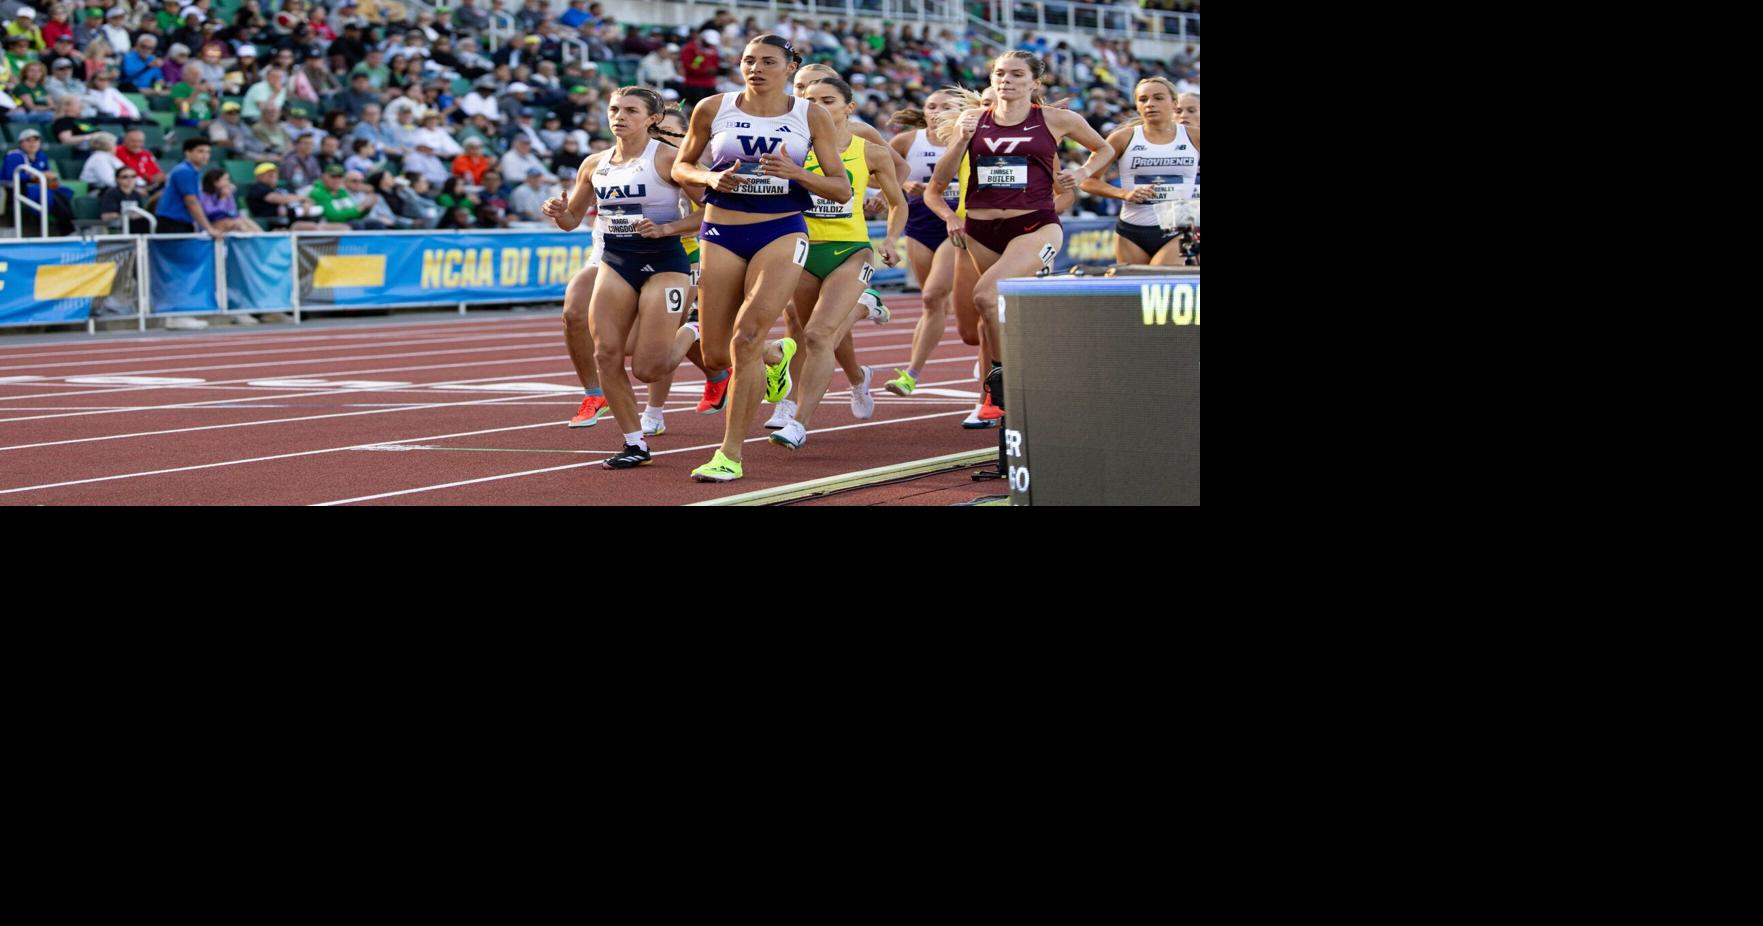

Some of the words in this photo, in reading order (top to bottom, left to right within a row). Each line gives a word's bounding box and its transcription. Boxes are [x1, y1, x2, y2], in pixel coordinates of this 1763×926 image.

[737, 135, 782, 156] W
[983, 136, 1034, 153] VT
[1130, 156, 1194, 169] PROVIDENCE
[987, 175, 1016, 183] BUTLER
[595, 184, 646, 199] NAU
[799, 240, 807, 263] 7
[1042, 246, 1056, 263] 11
[421, 249, 494, 288] NCAA
[500, 247, 531, 286] DI
[862, 265, 874, 283] 10
[690, 270, 700, 285] 1
[669, 289, 681, 311] 9
[1140, 283, 1200, 325] WO
